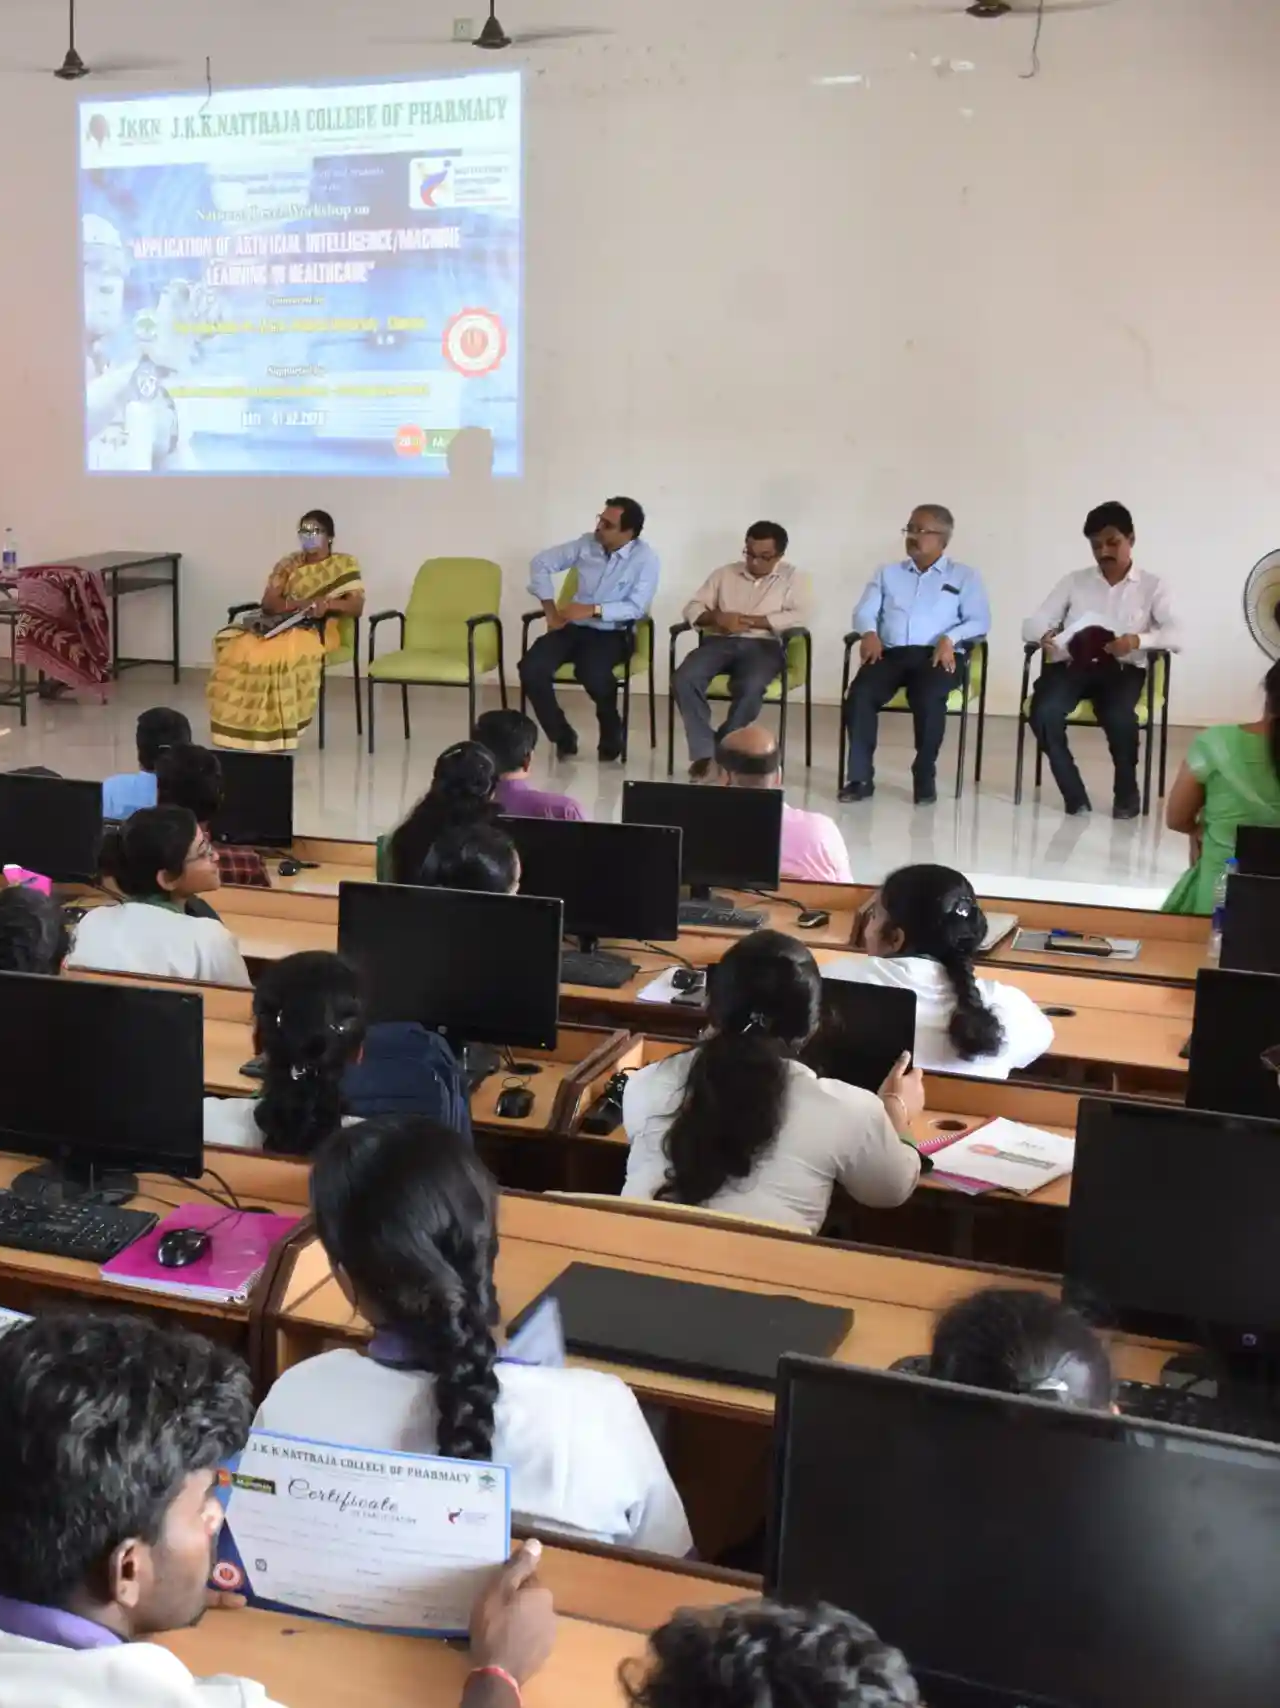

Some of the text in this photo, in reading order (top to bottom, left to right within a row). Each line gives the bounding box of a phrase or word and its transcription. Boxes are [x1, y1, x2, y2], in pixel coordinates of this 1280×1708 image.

[306, 104, 377, 131] COLLEGE
[382, 101, 404, 127] OF
[409, 95, 507, 126] PHARMACY
[340, 1458, 385, 1475] COLLEGE
[389, 1464, 404, 1476] OF
[407, 1467, 472, 1483] PHARMACY
[287, 1475, 400, 1513] Certificate
